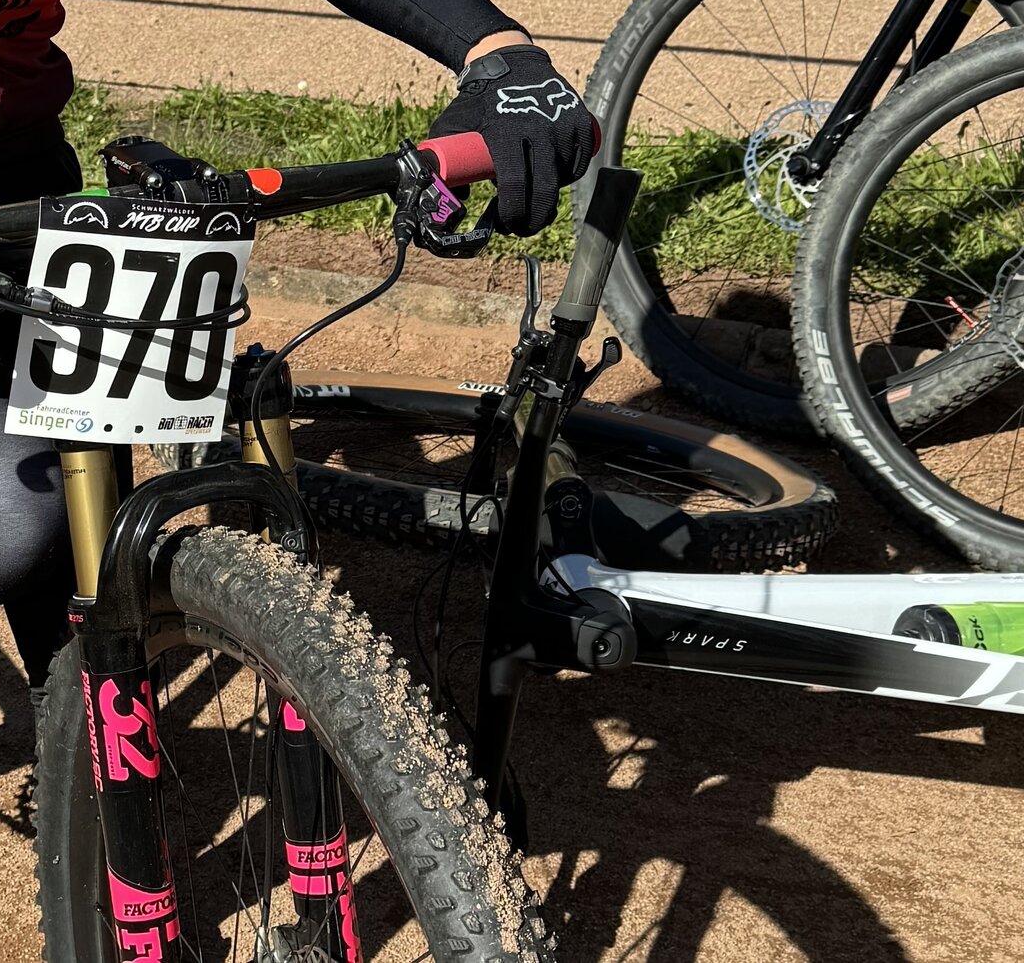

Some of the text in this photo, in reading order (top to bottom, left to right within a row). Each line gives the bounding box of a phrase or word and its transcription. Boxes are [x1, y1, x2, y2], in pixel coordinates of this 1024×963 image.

[613, 11, 653, 71] RON
[132, 203, 195, 215] SCHWARZWÄLDER
[119, 212, 201, 233] MTB CUP
[29, 243, 238, 401] 370
[19, 408, 74, 432] Singer
[37, 404, 90, 416] FahrradCenter
[812, 329, 960, 527] SCHWALBE
[665, 630, 748, 652] SPARK
[98, 678, 161, 781] 32
[297, 843, 347, 864] FACTO
